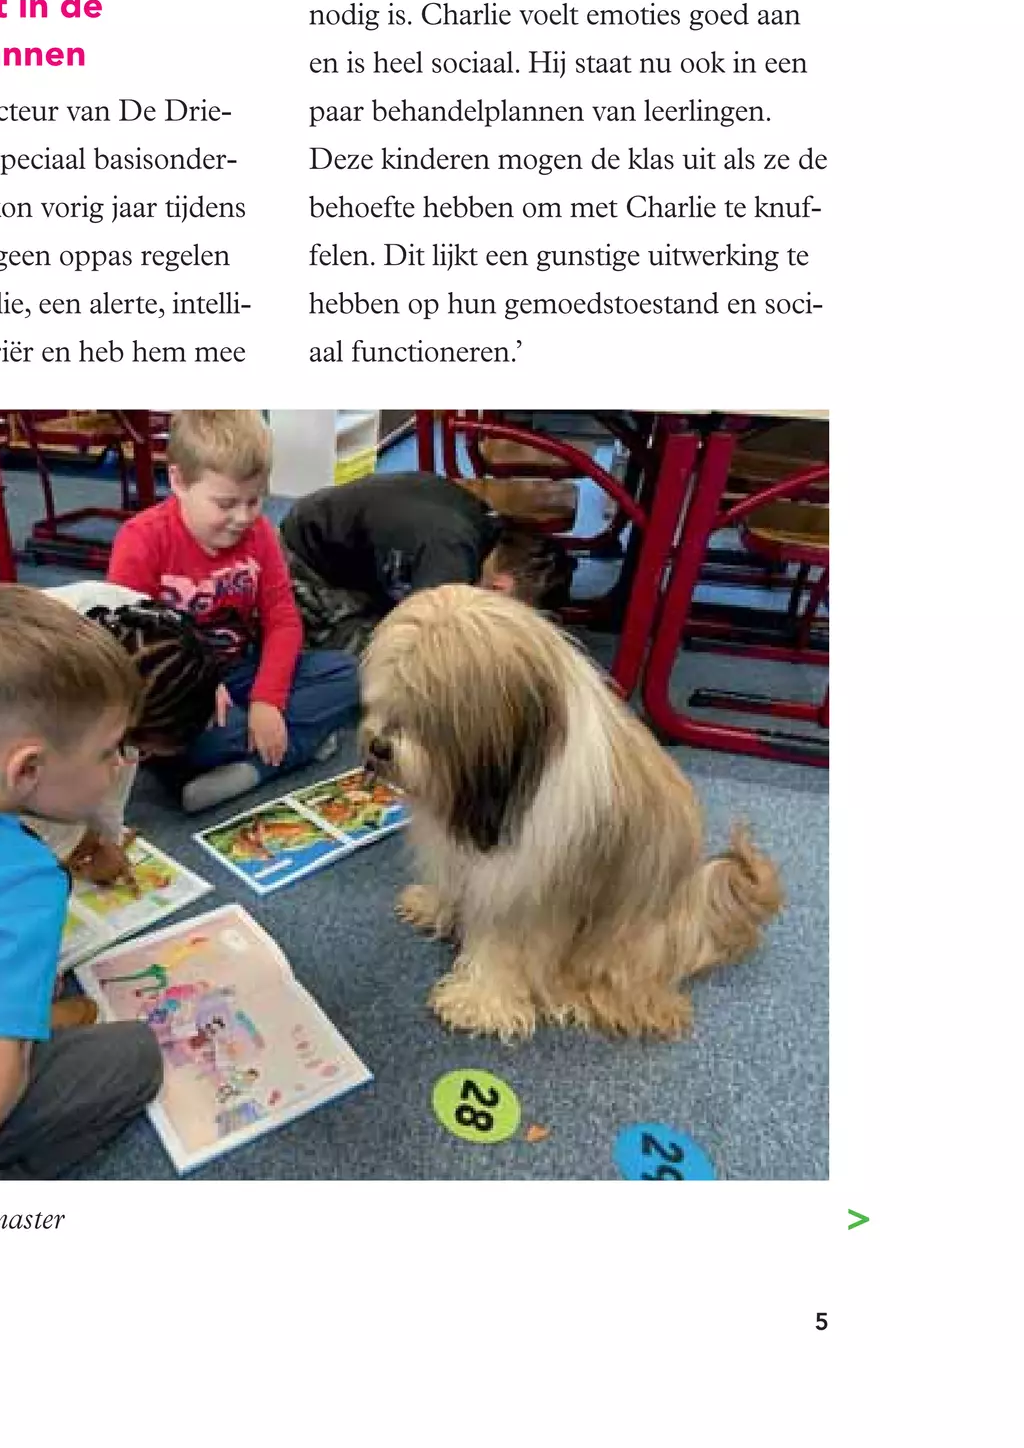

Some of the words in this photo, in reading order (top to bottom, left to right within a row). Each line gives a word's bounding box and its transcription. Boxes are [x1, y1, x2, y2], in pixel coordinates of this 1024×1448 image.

[309, 2, 380, 32] nodig
[387, 2, 412, 26] is.
[421, 2, 512, 26] Charlie
[519, 2, 580, 26] voelt
[586, 2, 681, 26] emoties
[689, 2, 750, 32] goed
[757, 9, 801, 26] aan
[41, 346, 71, 363] en
[78, 339, 124, 363] heb
[132, 339, 187, 363] hem
[194, 346, 246, 363] mee
[309, 339, 344, 363] aal
[455, 1079, 499, 1132] 28
[815, 1312, 828, 1331] 5
